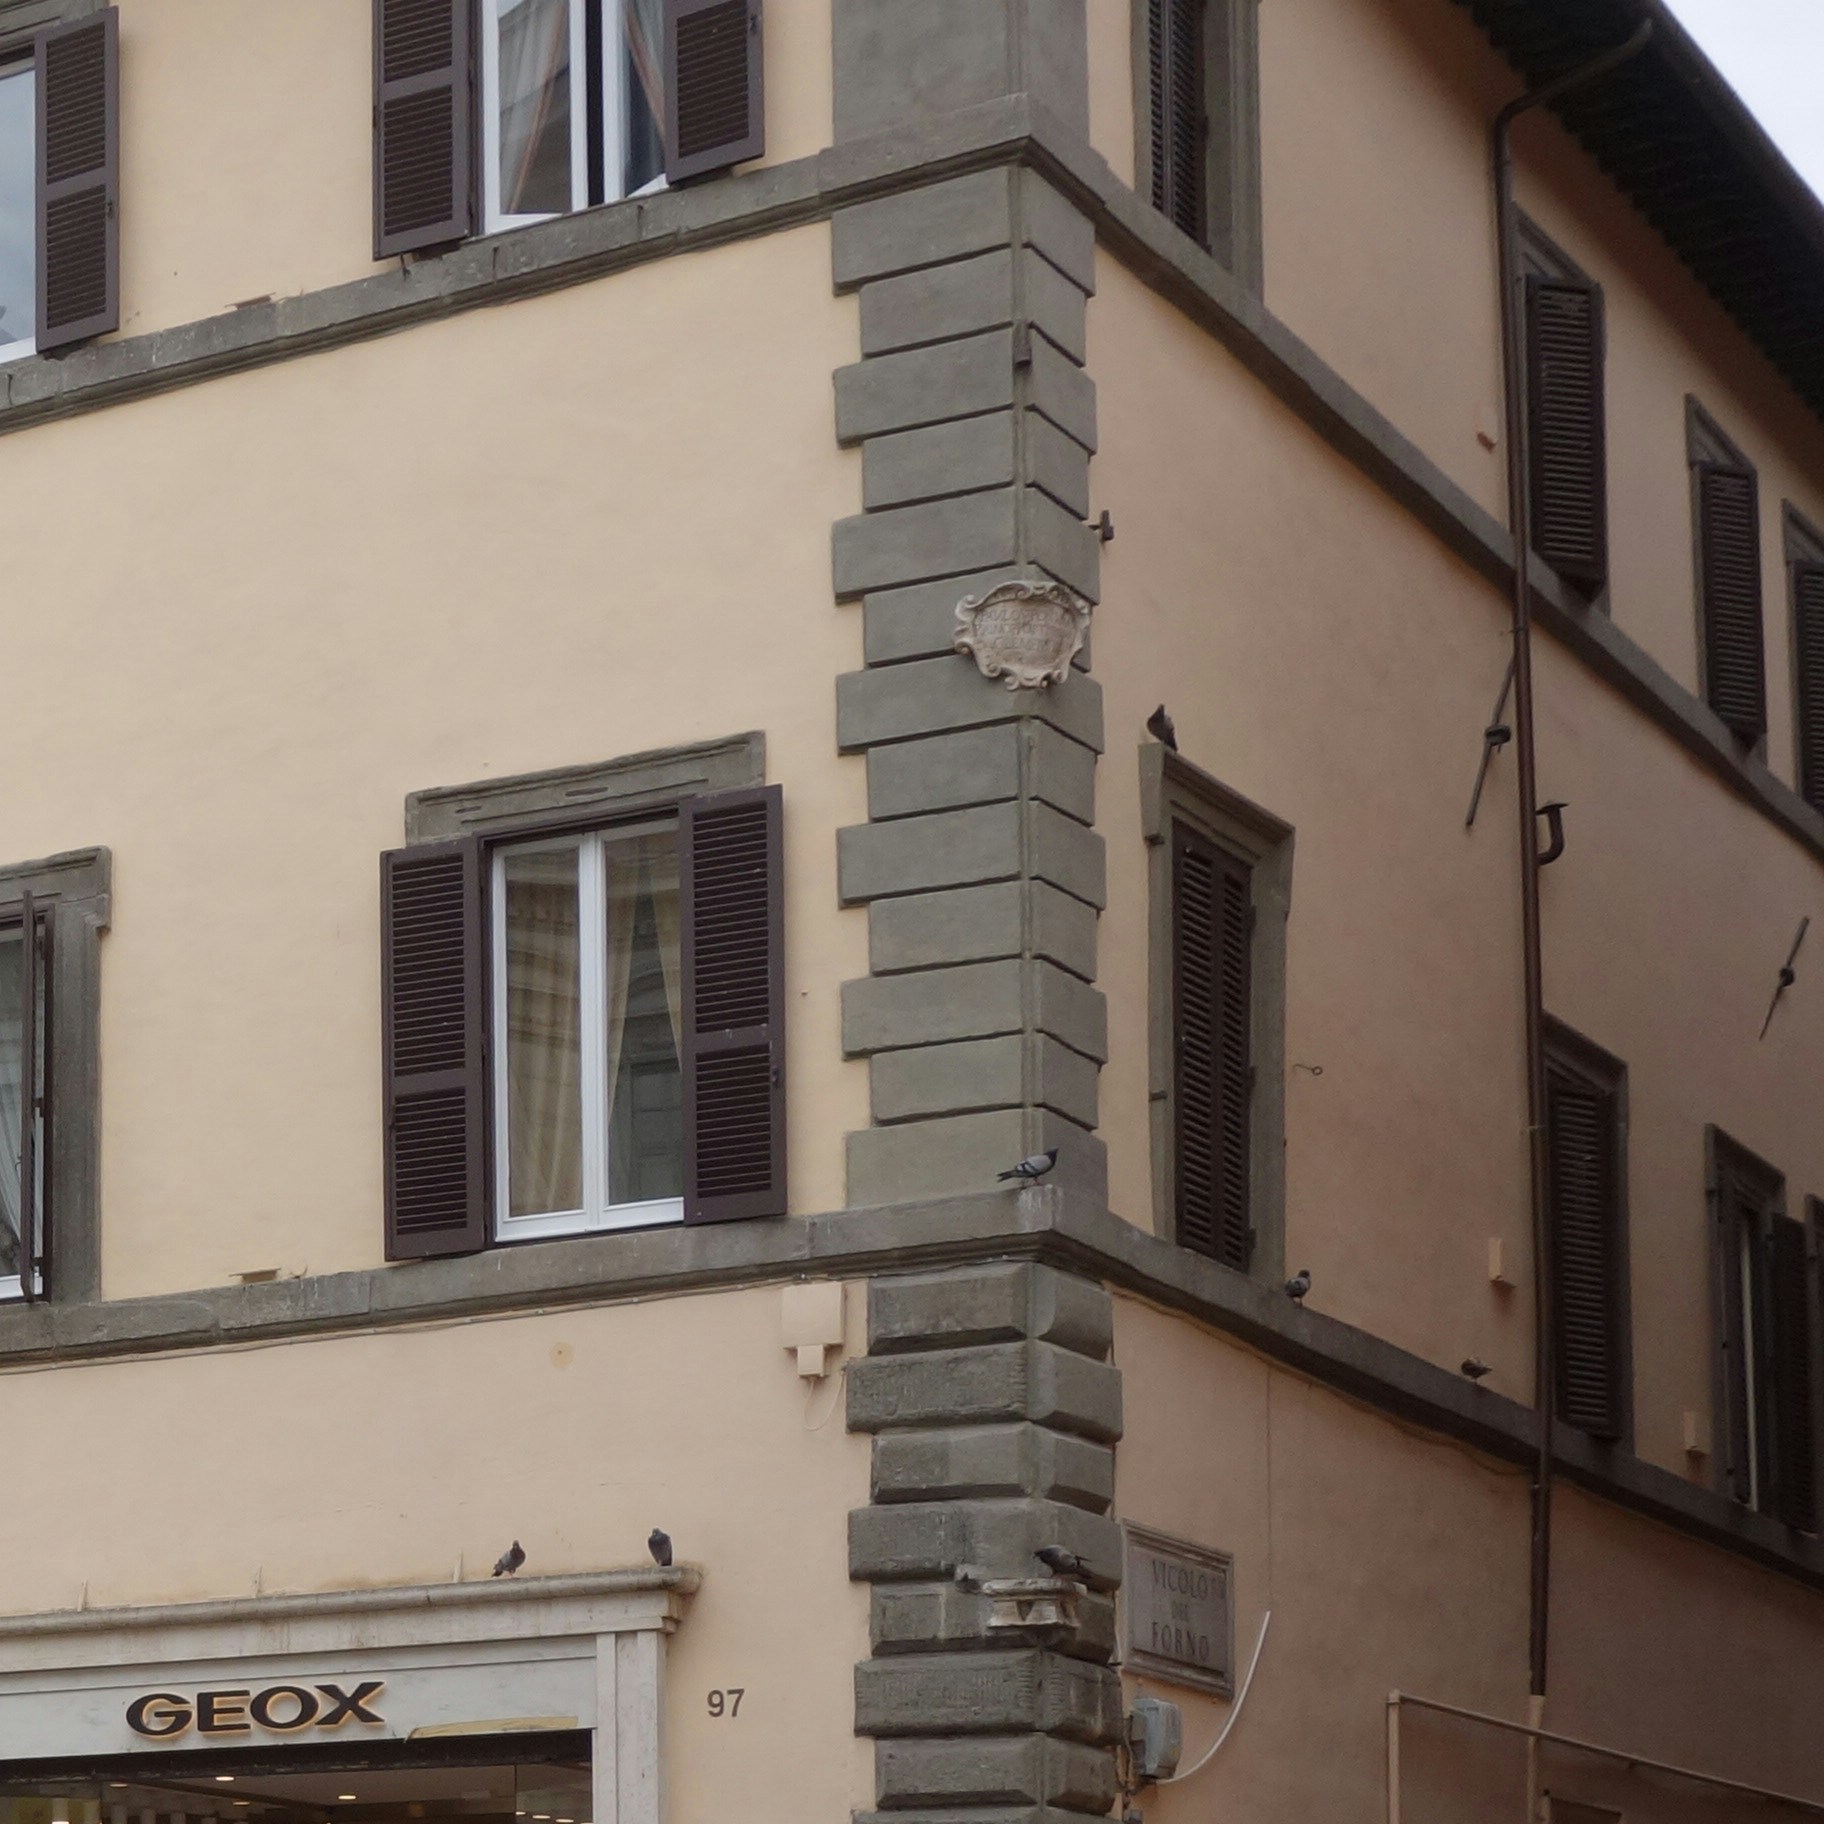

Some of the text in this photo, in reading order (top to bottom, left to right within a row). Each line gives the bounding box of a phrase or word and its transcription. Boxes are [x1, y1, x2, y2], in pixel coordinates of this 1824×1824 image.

[1152, 1560, 1209, 1600] VICOLO
[1152, 1621, 1209, 1662] FORNO
[126, 1681, 386, 1736] GEOX
[706, 1688, 746, 1718] 97
